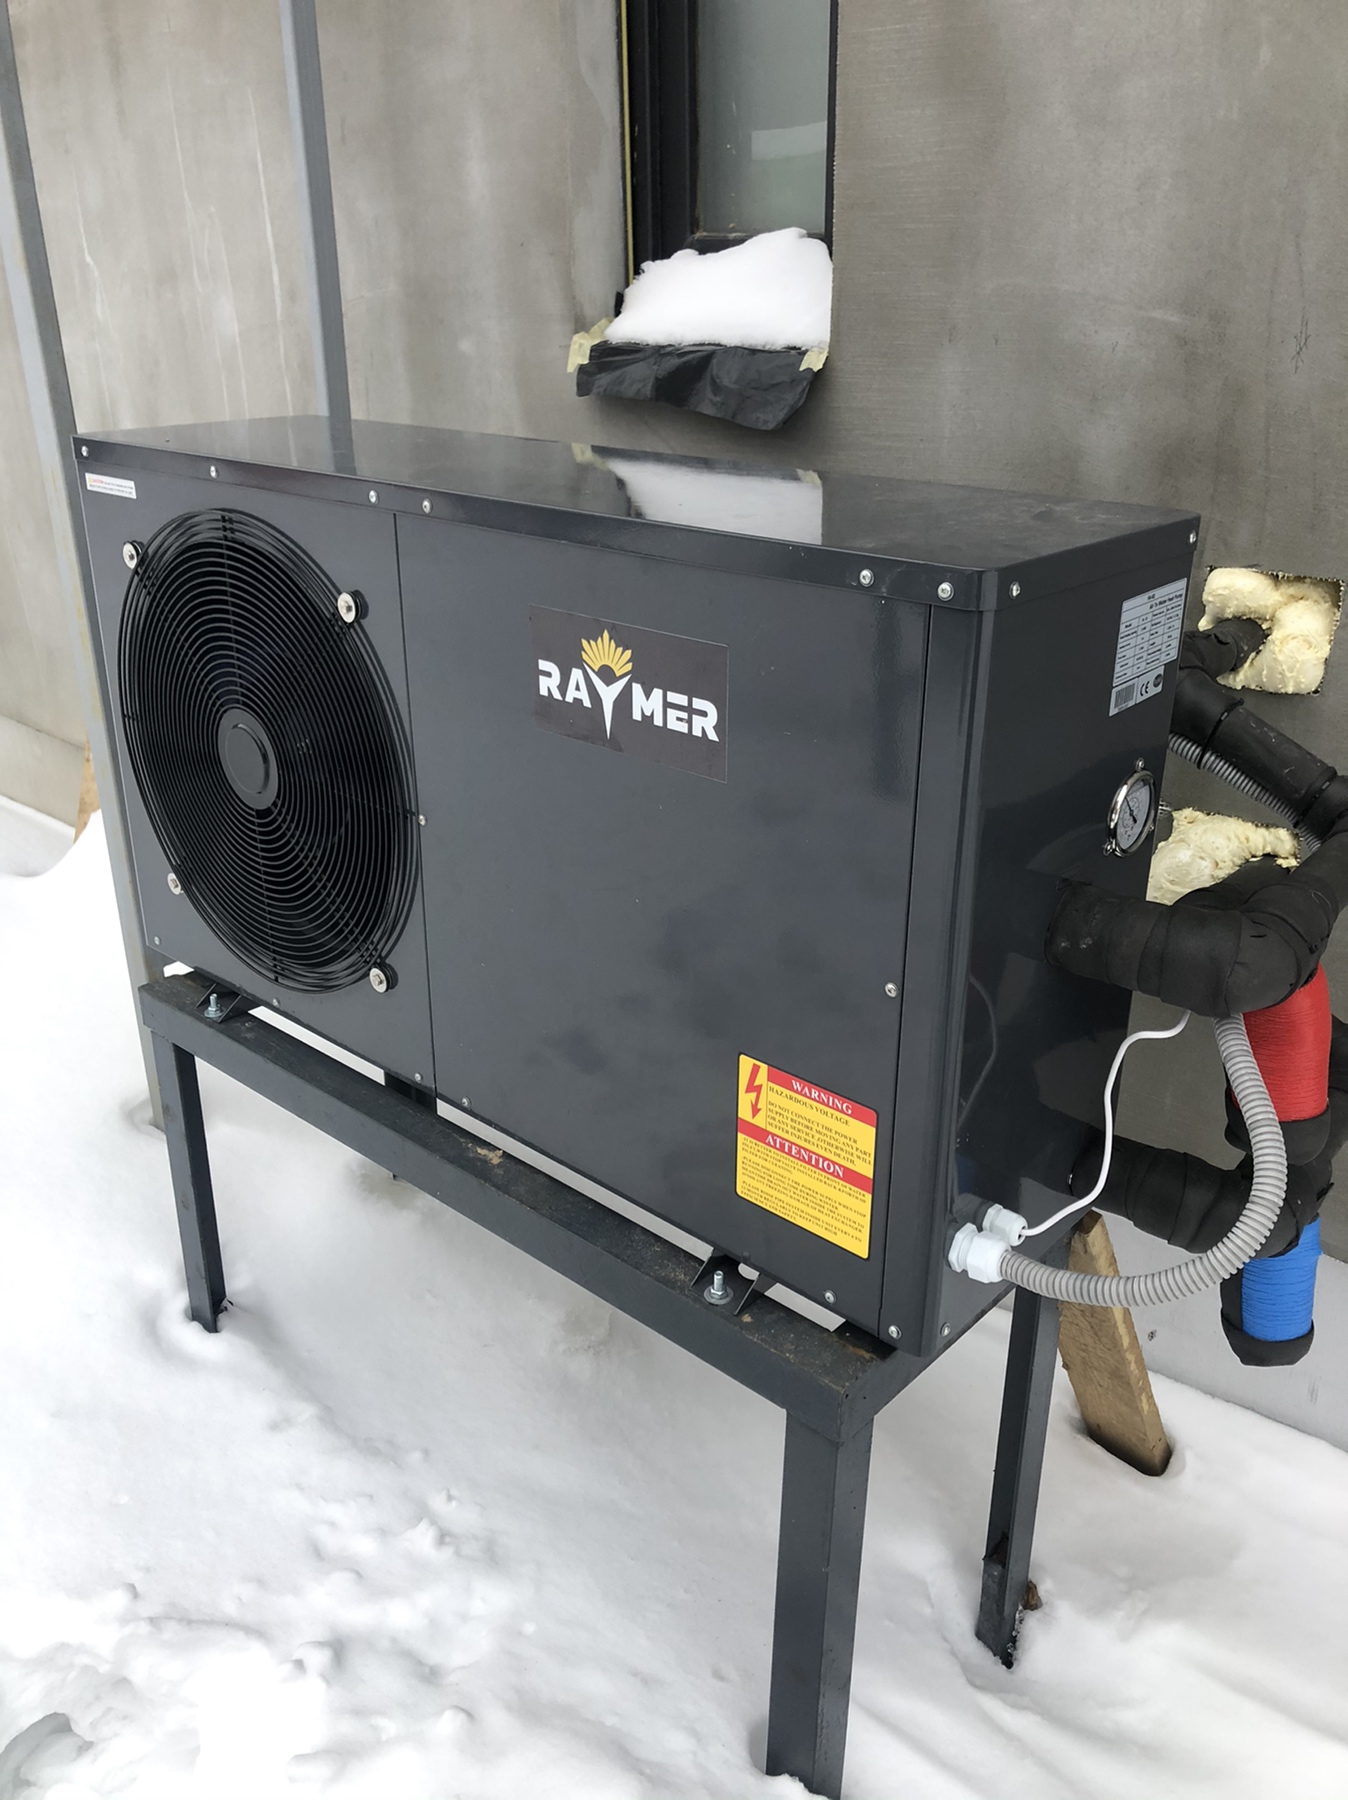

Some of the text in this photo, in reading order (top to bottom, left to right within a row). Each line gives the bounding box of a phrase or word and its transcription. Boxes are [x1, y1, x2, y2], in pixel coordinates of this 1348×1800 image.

[538, 658, 720, 742] RAYMER
[768, 1085, 849, 1127] HAZARDOUS VOLTAGE
[791, 1079, 852, 1115] WARNING
[765, 1131, 844, 1179] ATTENTION
